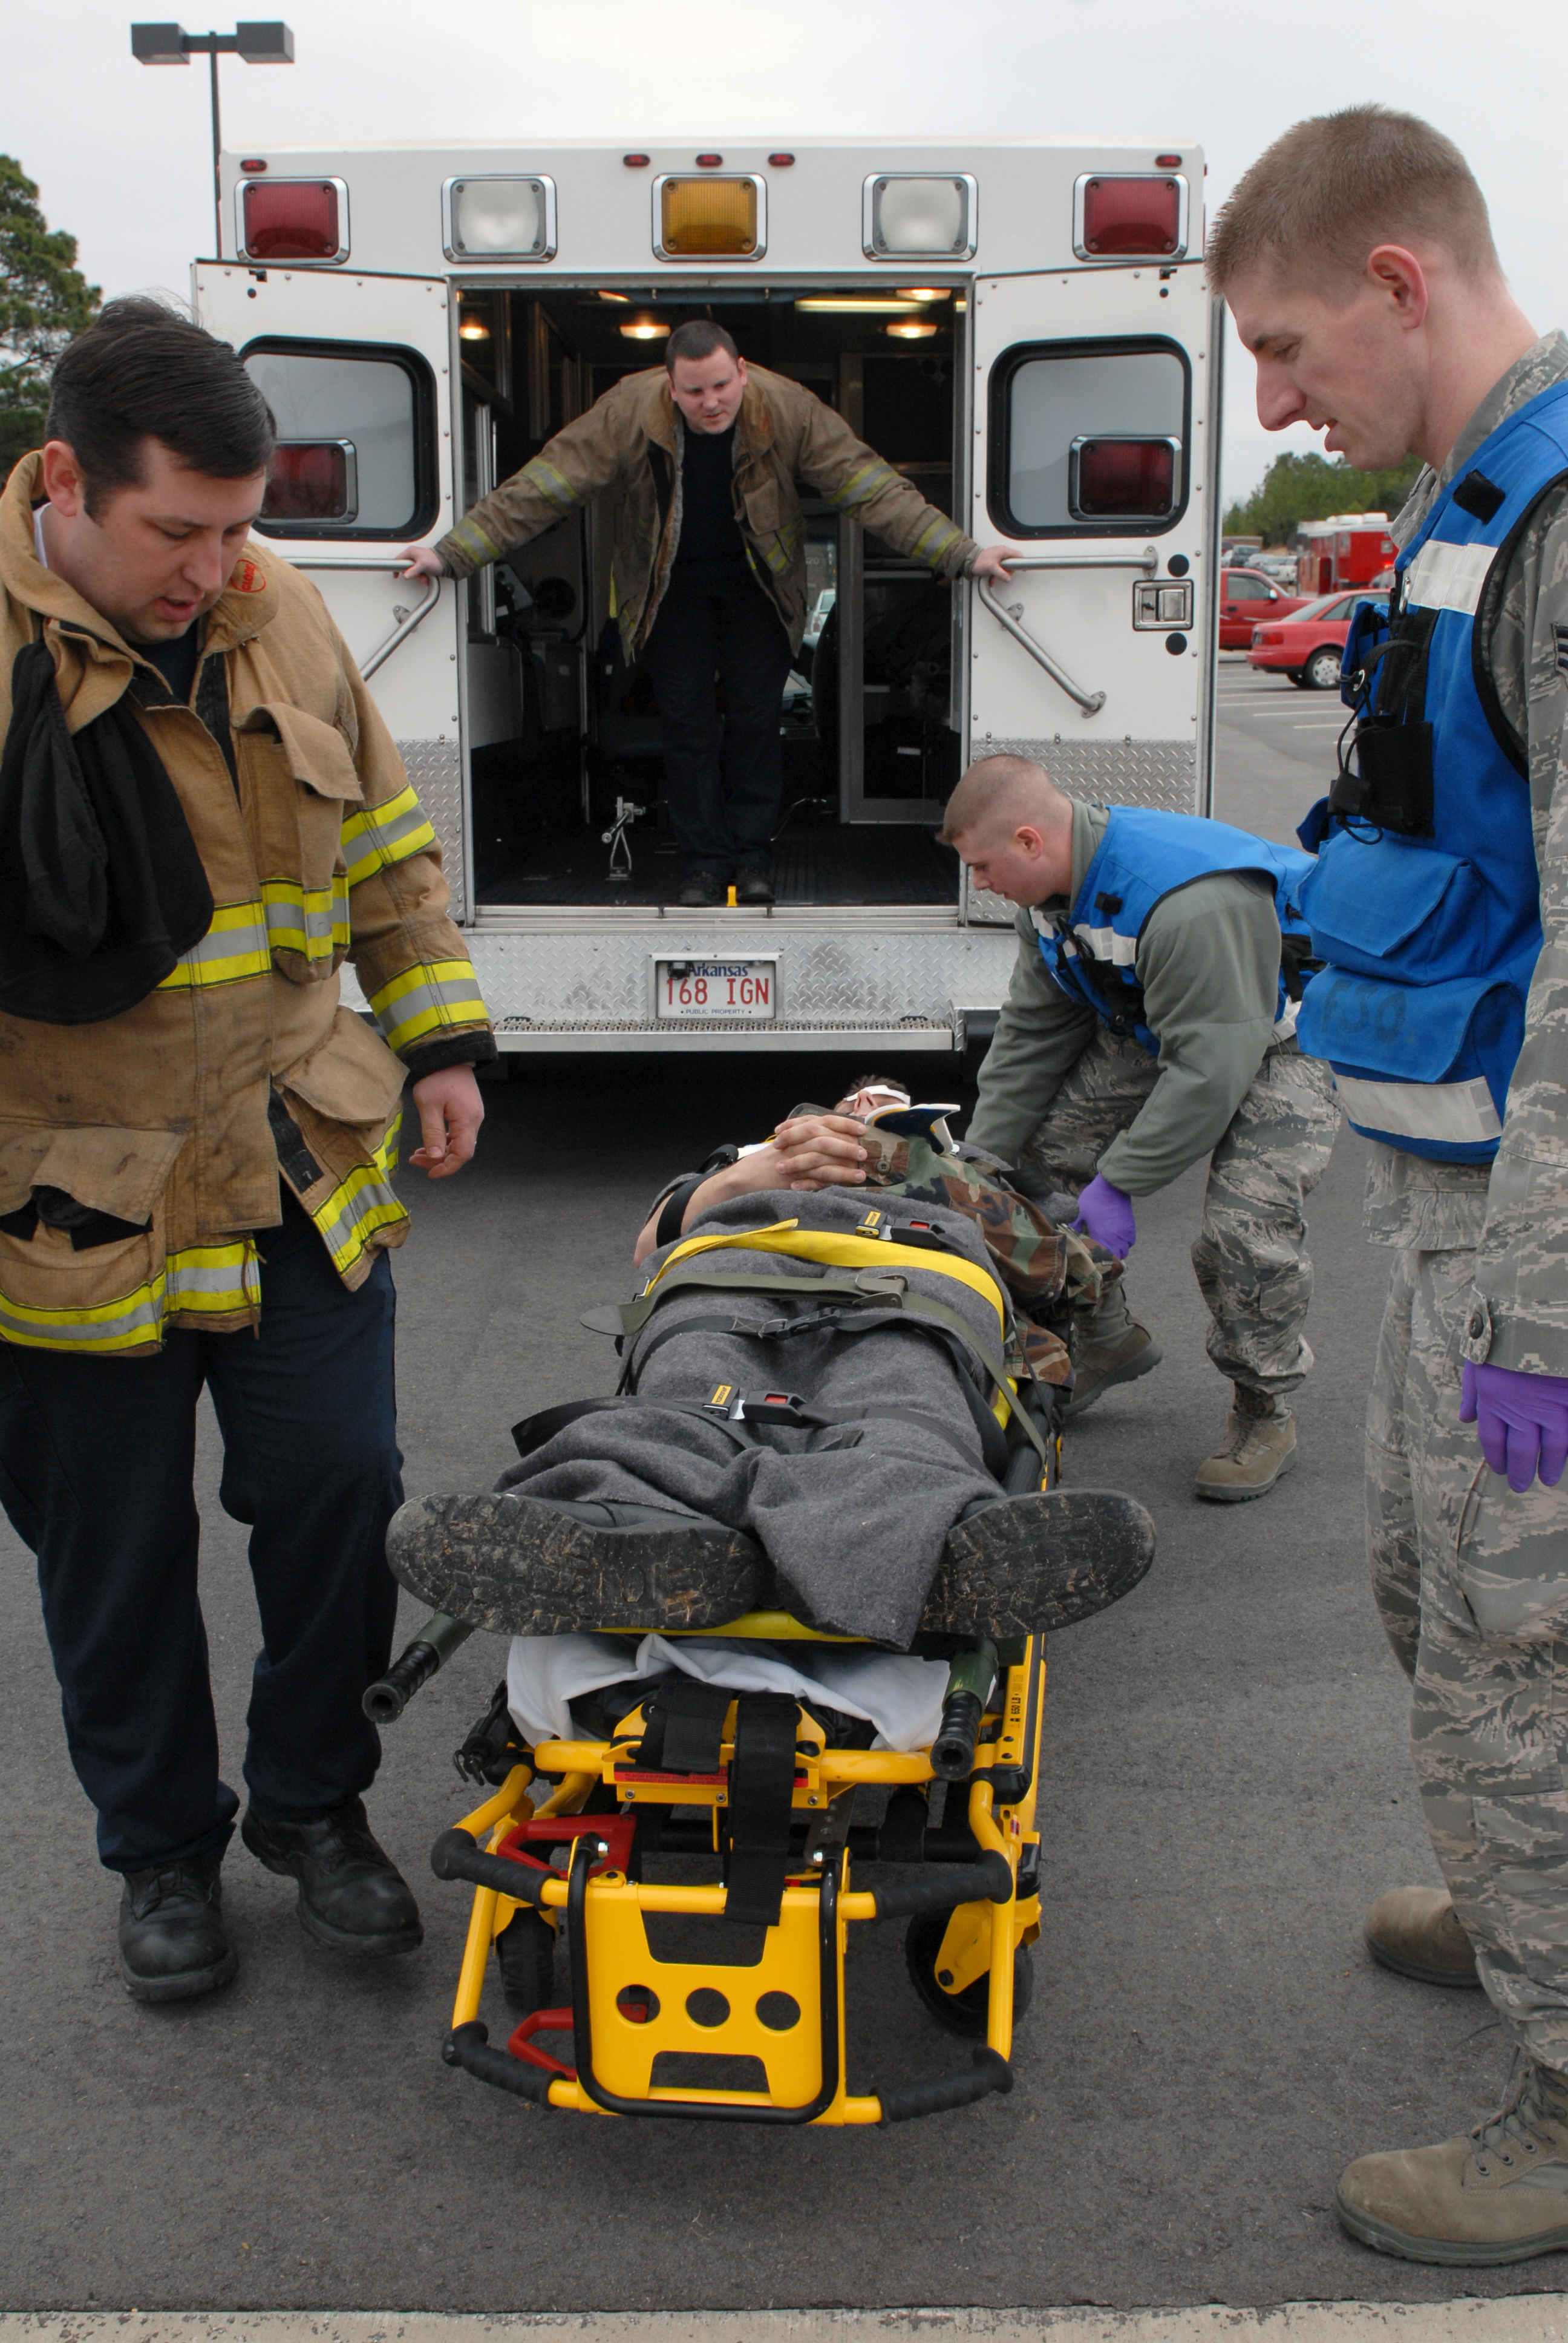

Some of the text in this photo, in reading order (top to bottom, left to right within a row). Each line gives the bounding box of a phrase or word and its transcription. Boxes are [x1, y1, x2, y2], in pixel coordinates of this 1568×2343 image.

[691, 963, 748, 977] Arkansas
[667, 978, 769, 1004] 168 IGN
